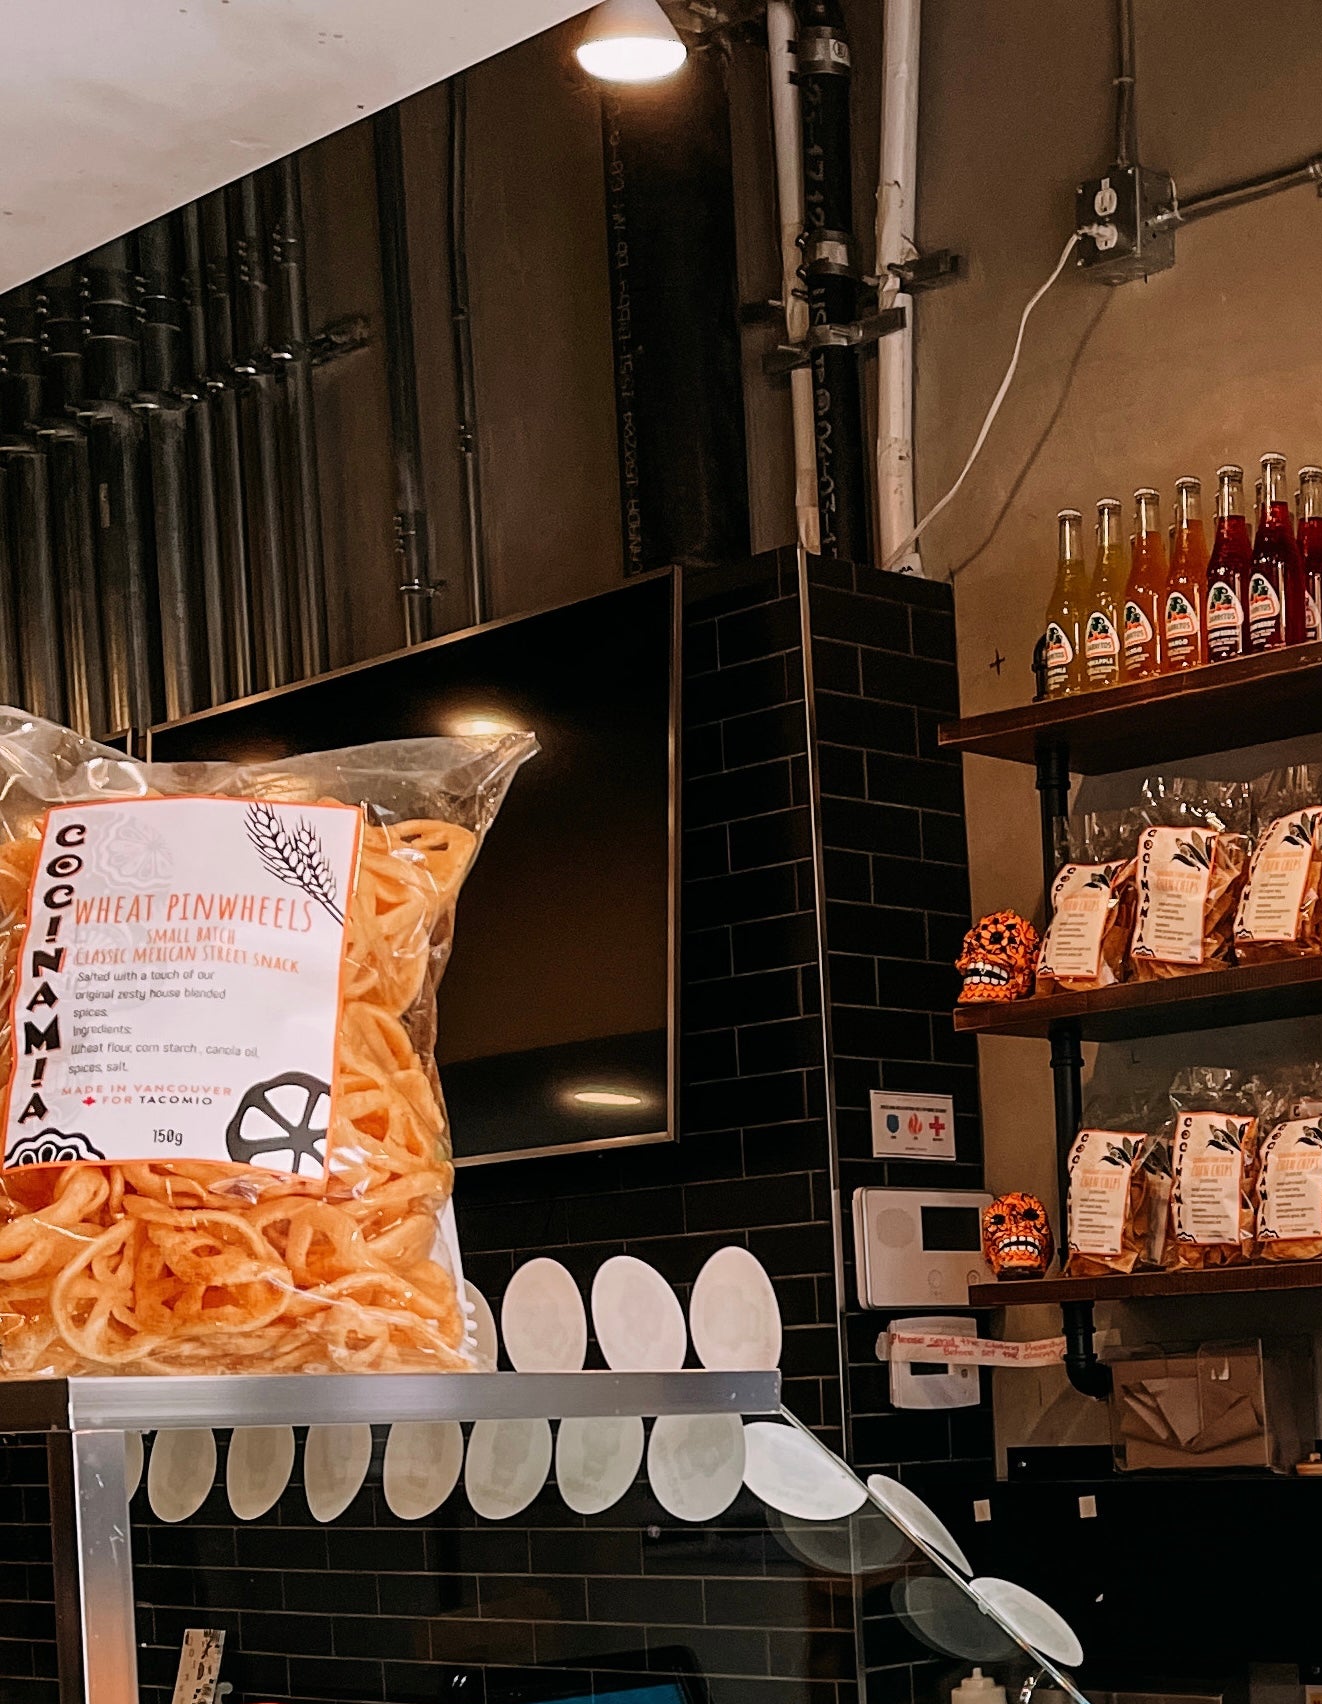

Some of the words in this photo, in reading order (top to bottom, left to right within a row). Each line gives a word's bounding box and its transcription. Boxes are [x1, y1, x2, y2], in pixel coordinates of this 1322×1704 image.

[74, 894, 156, 925] WHEAT
[166, 892, 313, 933] PINWHEELS
[147, 927, 190, 945] SMALL
[196, 925, 236, 945] BATCH
[74, 947, 128, 966] CLASSIC
[132, 946, 197, 965] MEXICAN
[202, 944, 248, 965] STREET
[253, 953, 301, 975] SNACK
[77, 971, 111, 983] Salted
[113, 970, 138, 982] with
[140, 972, 148, 981] a
[150, 969, 180, 981] touch
[182, 968, 195, 980] of
[197, 971, 215, 980] our
[75, 988, 115, 1001] original
[117, 988, 147, 1001] zesty
[149, 987, 181, 999] house
[184, 987, 227, 1000] blended
[61, 1084, 104, 1096] MADE
[110, 1084, 127, 1094] IN
[133, 1084, 233, 1096] VANCOUVER
[102, 1095, 133, 1105] FOR
[139, 1095, 213, 1105] TACOMIO
[152, 1128, 184, 1147] 150g
